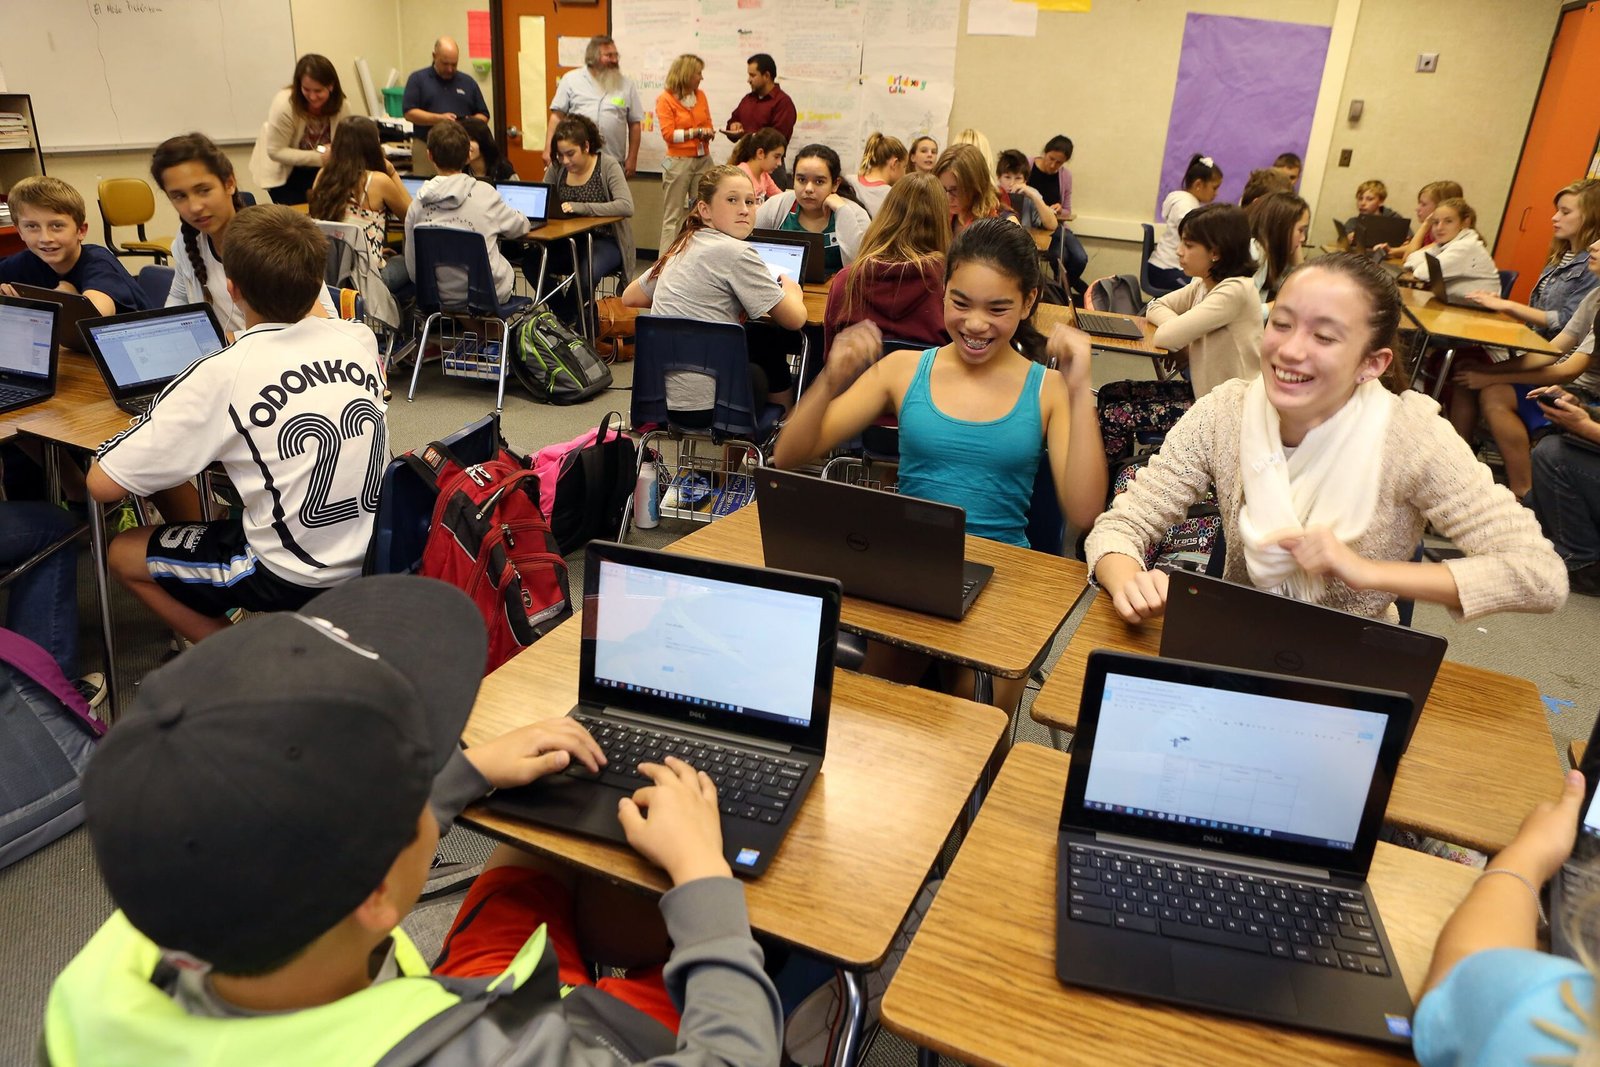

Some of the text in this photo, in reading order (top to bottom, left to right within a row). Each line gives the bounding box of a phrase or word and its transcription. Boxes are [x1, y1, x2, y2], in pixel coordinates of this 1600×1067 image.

[249, 359, 378, 427] ODONKOR
[277, 398, 385, 528] 22
[1173, 537, 1198, 546] trans
[689, 710, 706, 720] DELL
[1202, 834, 1224, 845] DELL
